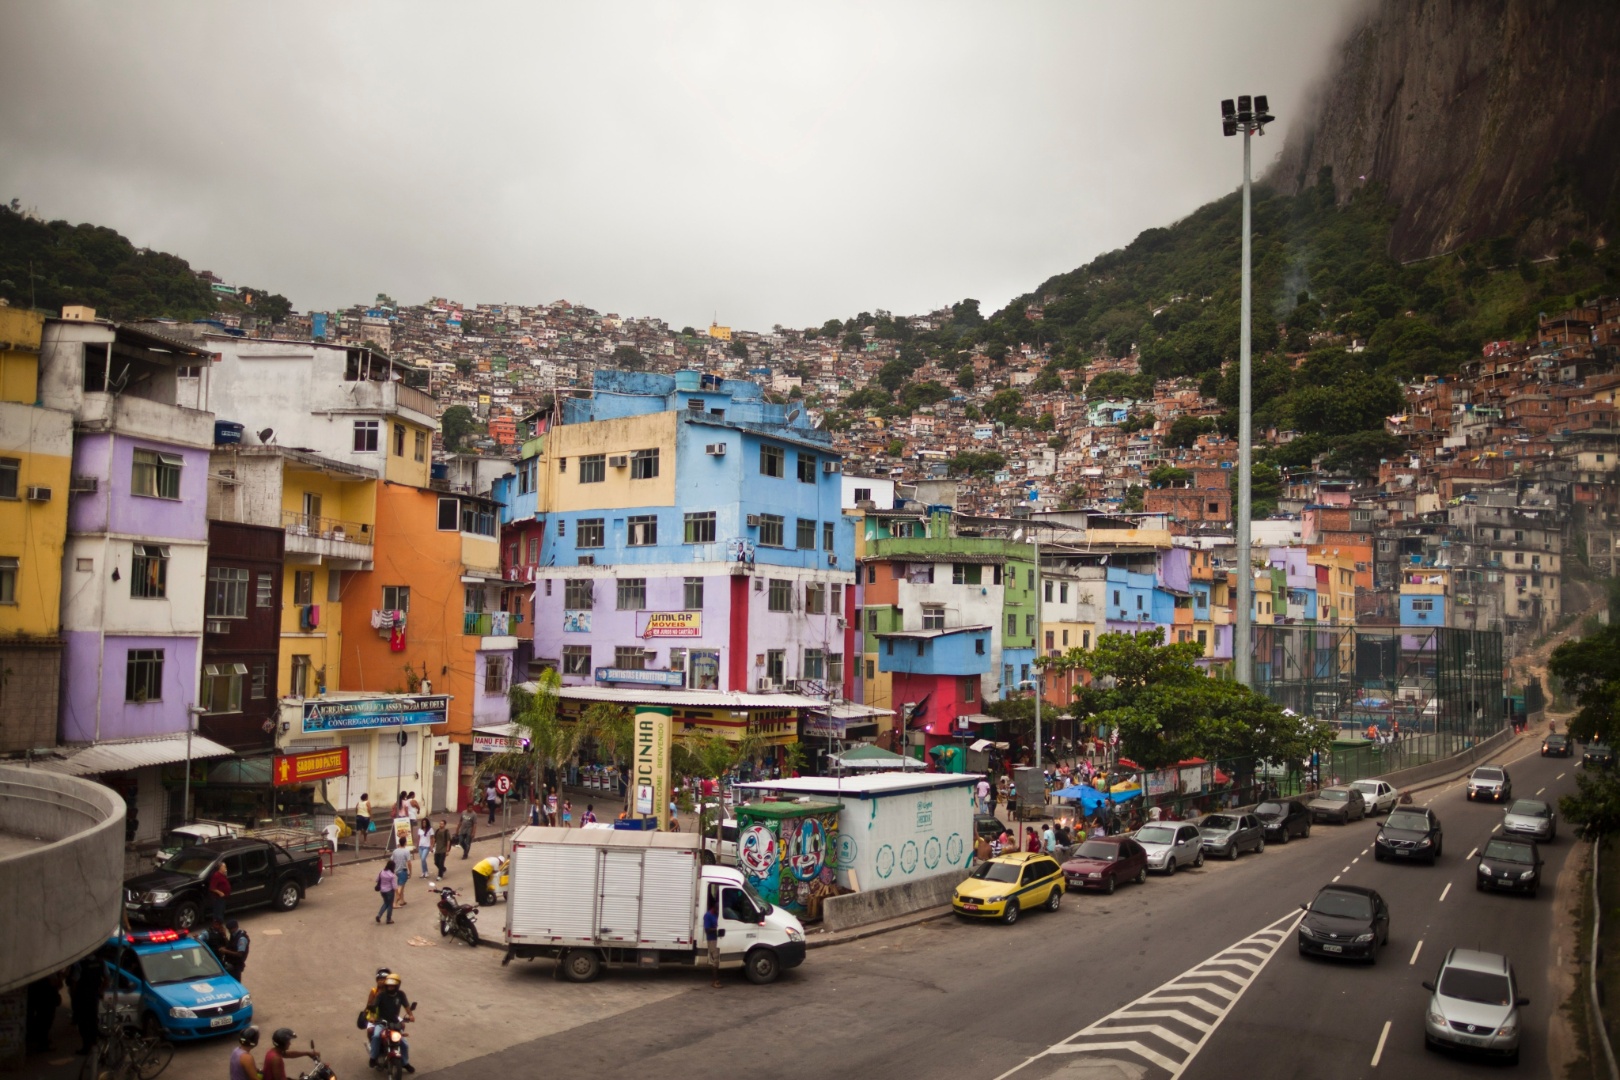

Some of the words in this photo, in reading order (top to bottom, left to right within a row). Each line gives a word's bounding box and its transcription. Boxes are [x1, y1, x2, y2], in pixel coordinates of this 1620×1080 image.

[420, 701, 430, 710] DE
[429, 699, 445, 709] DEUS
[638, 720, 654, 786] OCINHA
[296, 760, 315, 773] SABOR
[315, 757, 323, 769] DO
[323, 754, 342, 768] PASTEL
